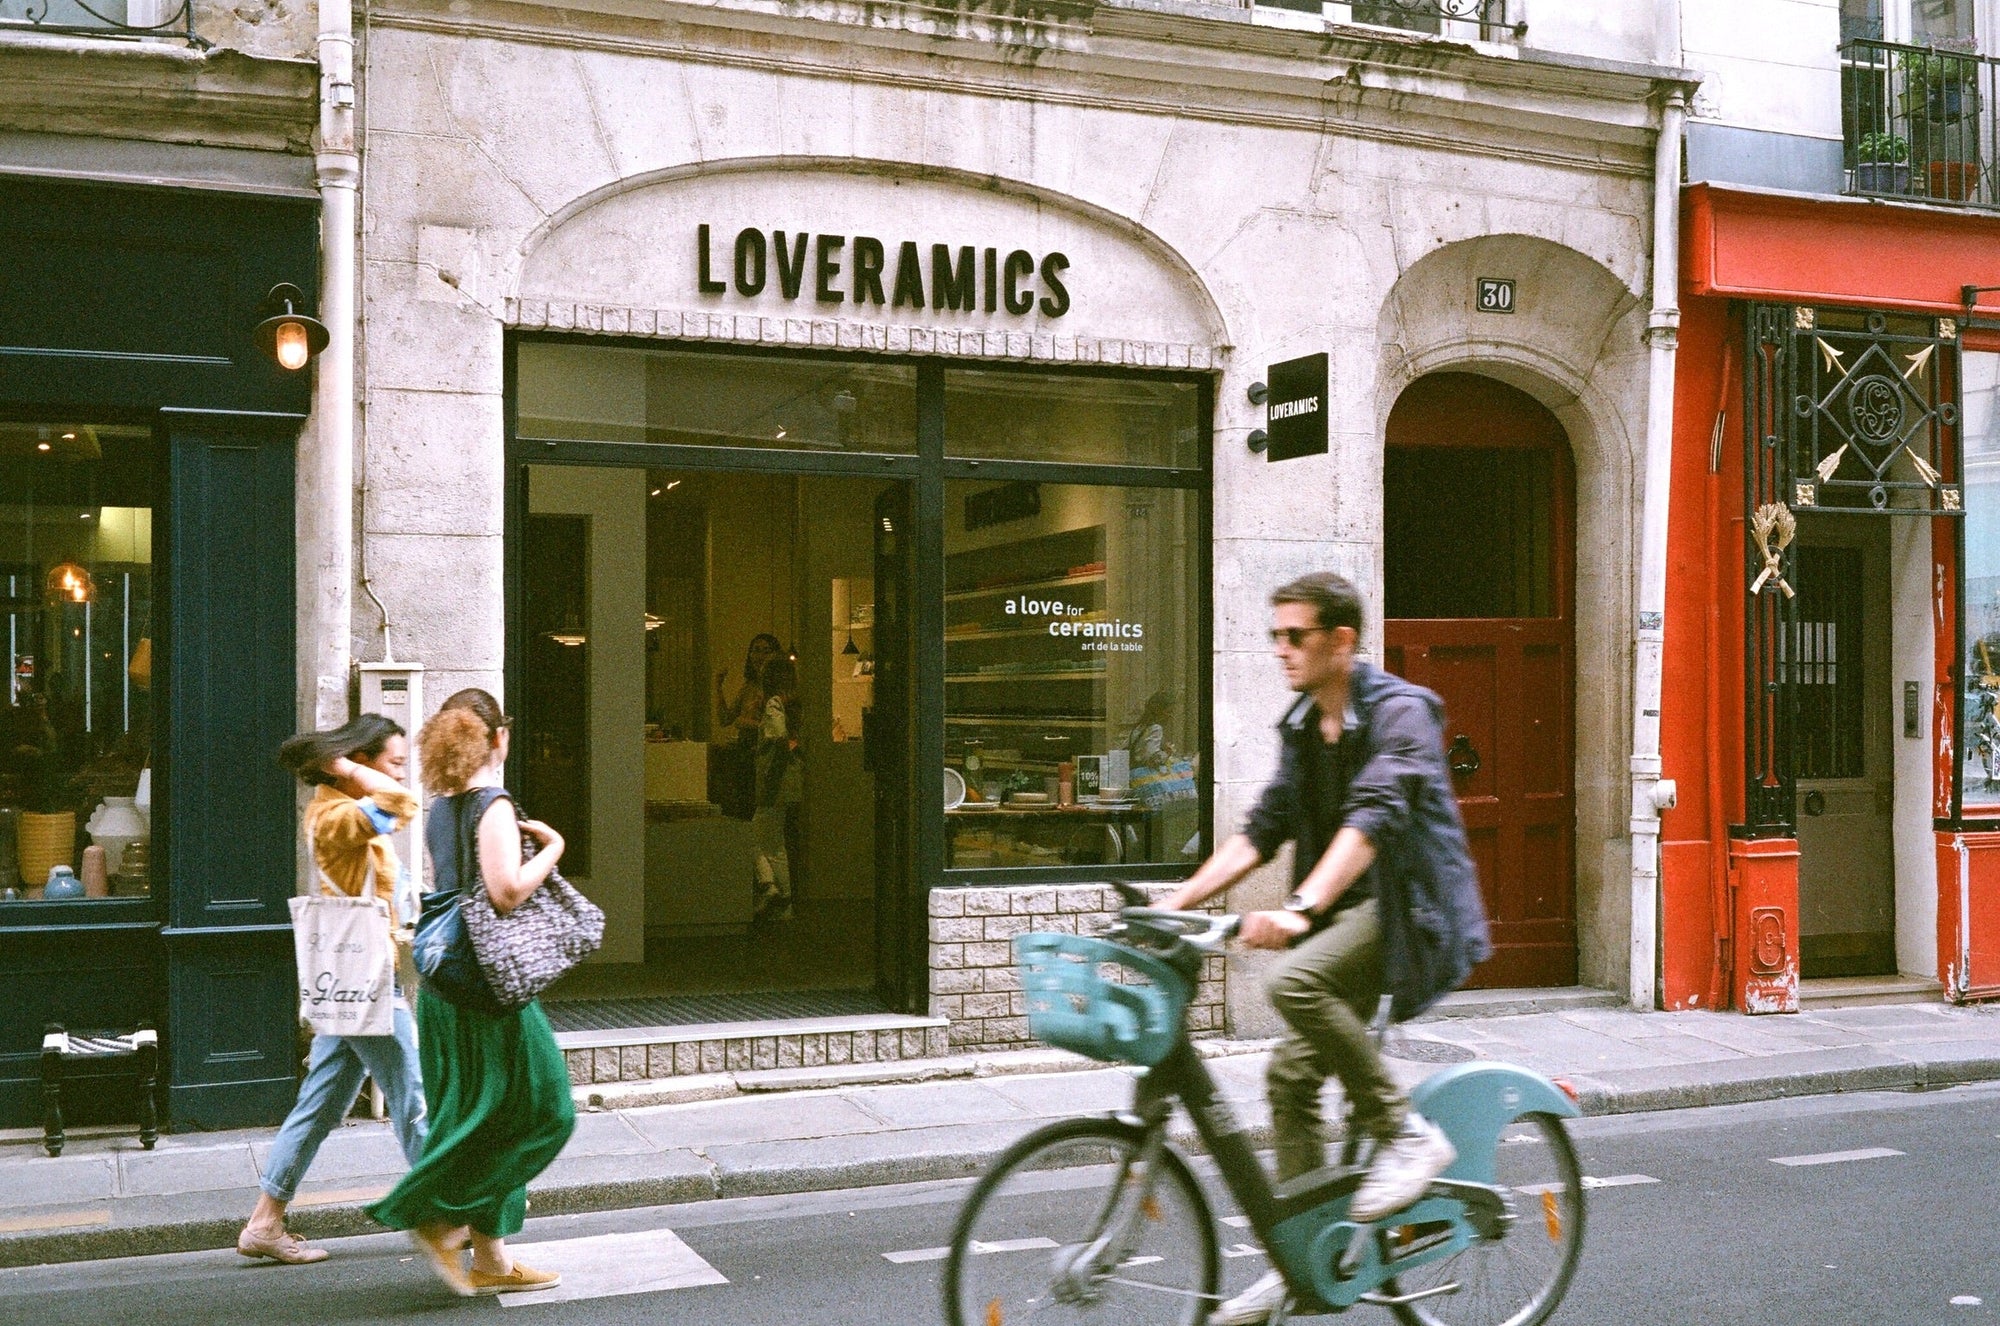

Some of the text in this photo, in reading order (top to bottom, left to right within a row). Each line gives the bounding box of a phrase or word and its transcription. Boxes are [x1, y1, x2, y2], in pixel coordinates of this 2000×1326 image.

[698, 223, 1071, 319] LOVERAMICS
[1483, 282, 1511, 308] 30
[1270, 396, 1319, 421] LOVERAMICS
[1004, 595, 1085, 617] a love for
[1048, 618, 1143, 638] ceramics
[1081, 642, 1143, 652] art de la table
[1080, 771, 1099, 781] 10%
[310, 970, 379, 1006] Glazik
